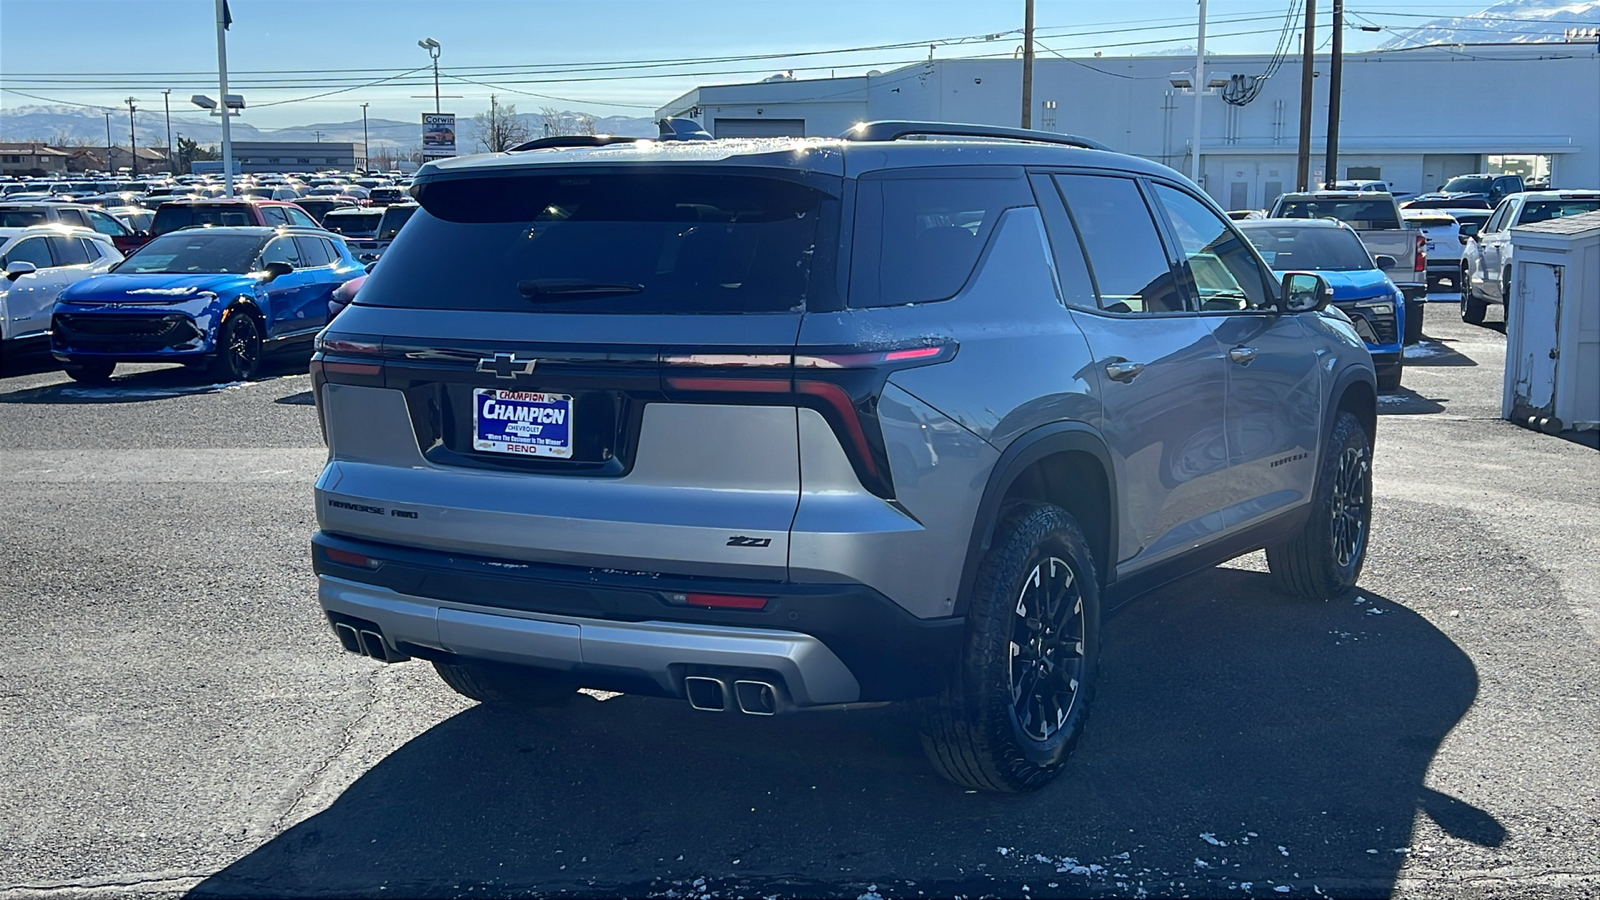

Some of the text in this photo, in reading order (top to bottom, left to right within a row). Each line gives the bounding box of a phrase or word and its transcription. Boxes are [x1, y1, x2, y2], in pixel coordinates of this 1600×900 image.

[425, 115, 455, 123] Corwin
[499, 391, 545, 402] CHAMPION
[482, 400, 565, 424] CHAMPION
[507, 424, 539, 433] CHEVROLET
[507, 444, 537, 453] RENO
[328, 499, 418, 519] TRAVERSE AWD
[726, 535, 772, 548] Z71
